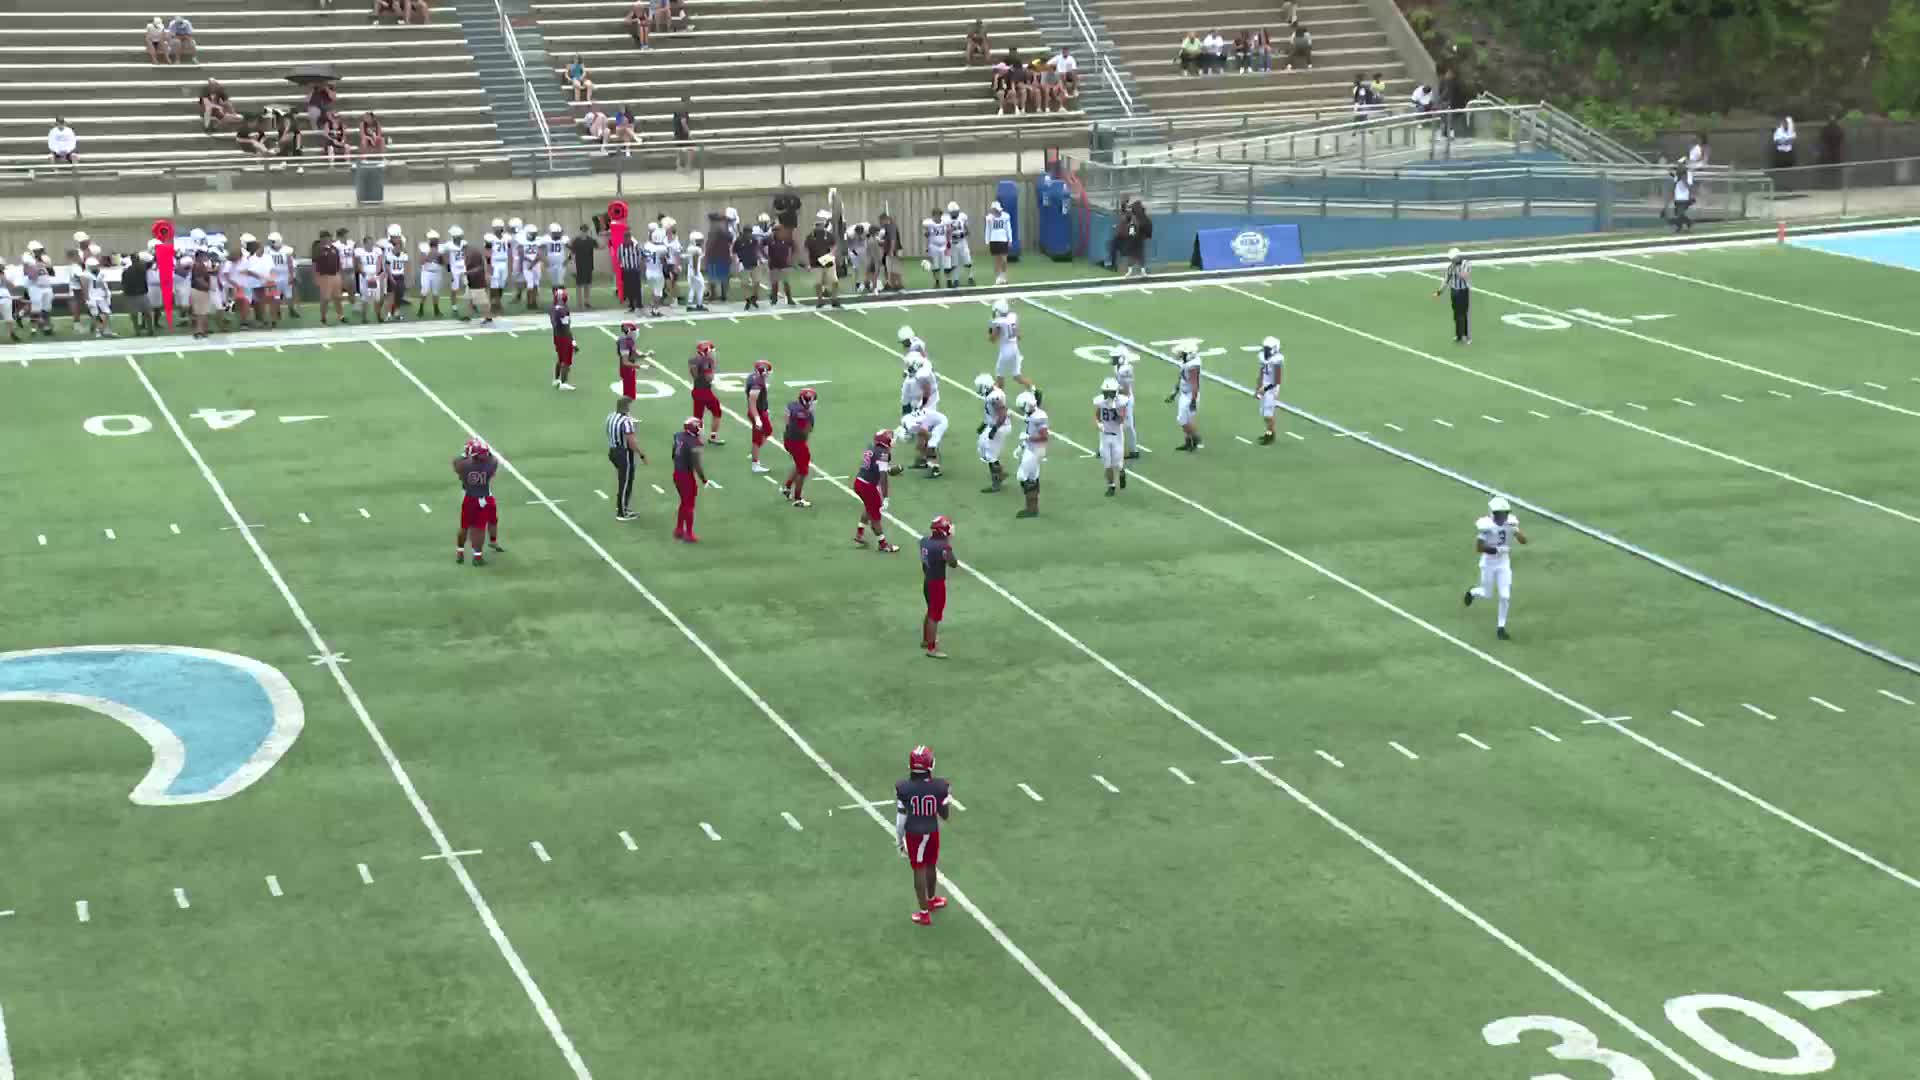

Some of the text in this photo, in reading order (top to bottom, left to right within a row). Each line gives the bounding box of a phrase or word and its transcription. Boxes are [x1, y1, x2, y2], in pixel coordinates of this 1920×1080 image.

[83, 408, 257, 436] 40
[910, 794, 937, 817] 10
[1481, 993, 1836, 1080] 30
